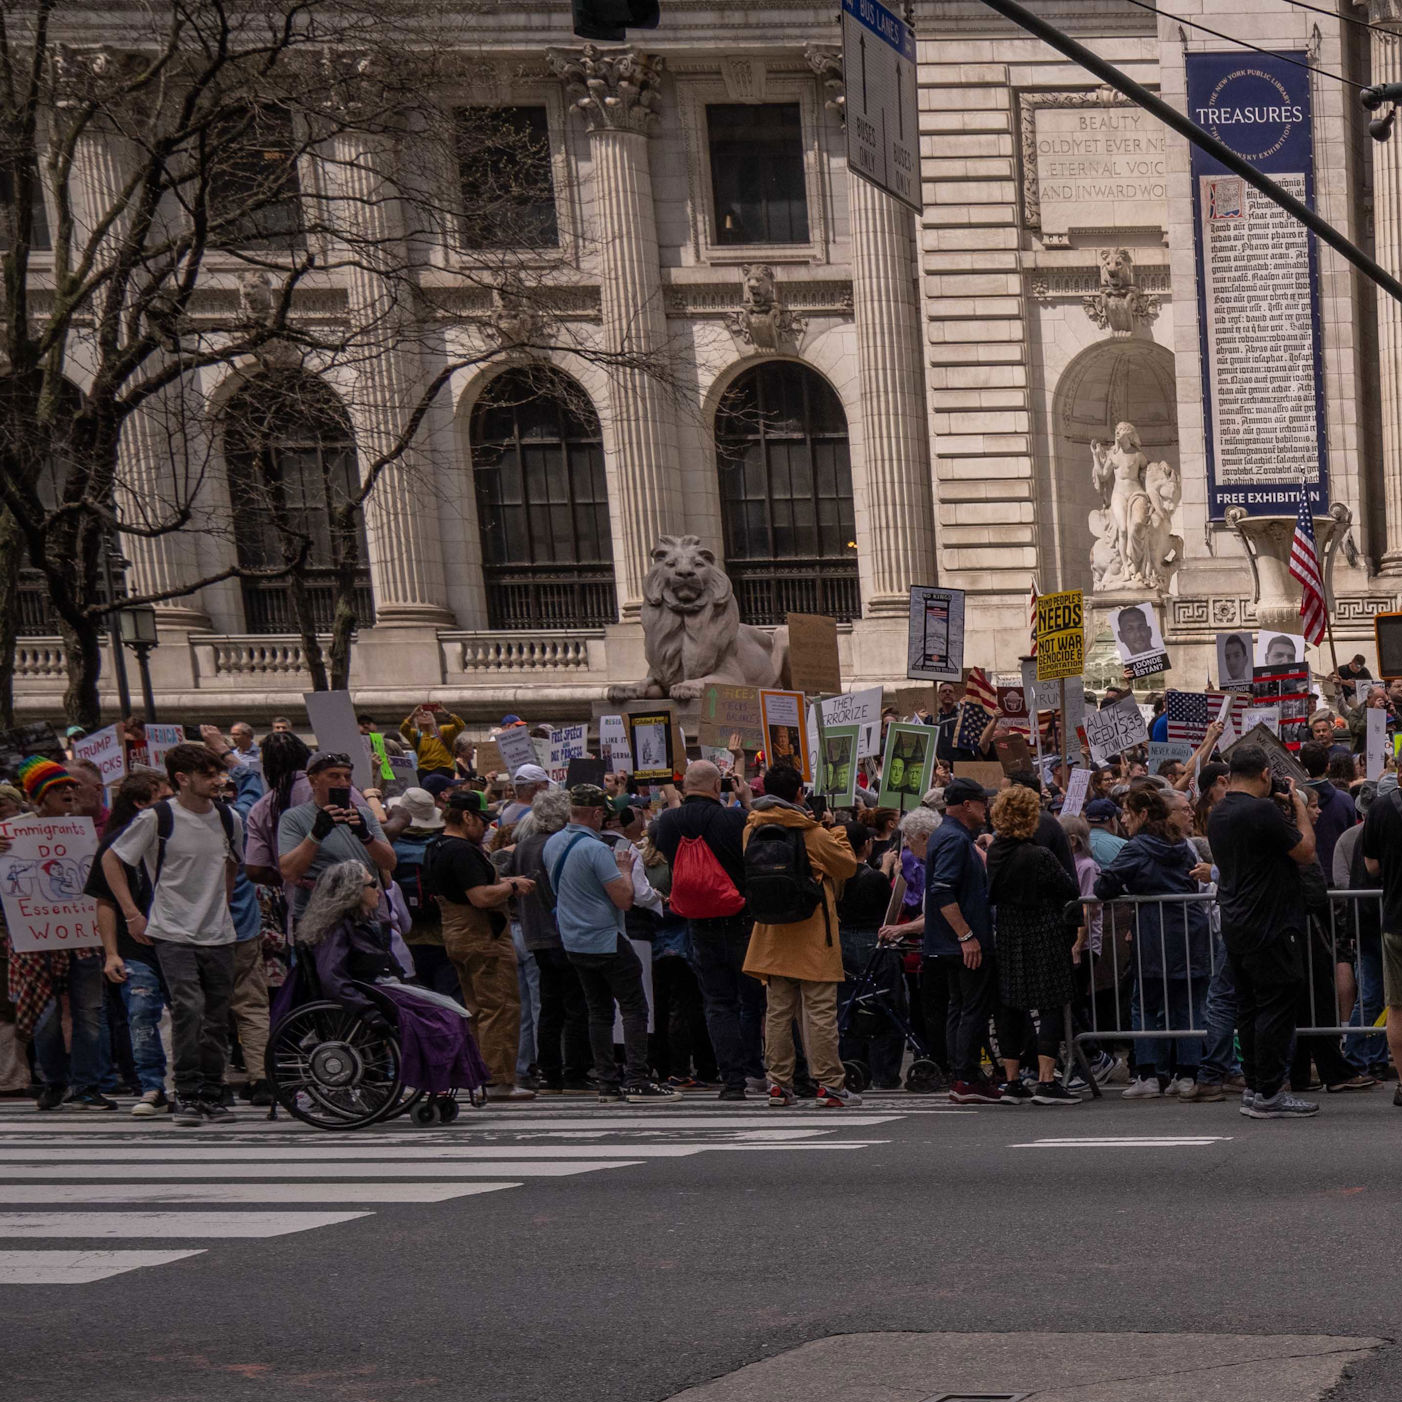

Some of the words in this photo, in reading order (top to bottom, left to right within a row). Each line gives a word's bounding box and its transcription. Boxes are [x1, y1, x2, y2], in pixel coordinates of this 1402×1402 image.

[877, 13, 900, 45] LANES
[1215, 77, 1229, 92] NEW
[1227, 69, 1246, 81] YORK
[1247, 69, 1272, 82] PUBLIC
[1271, 78, 1292, 105] LIBRARY
[1079, 116, 1141, 130] BEAUTY
[1196, 106, 1303, 124] TREASURES
[856, 117, 876, 148] BUSES
[1039, 140, 1071, 153] OLD
[1073, 139, 1101, 152] YET
[1106, 139, 1142, 152] EVER
[1259, 124, 1292, 160] EXHIBITION
[859, 147, 876, 174] ONLY
[893, 142, 912, 173] BUSES
[1050, 162, 1121, 176] ETERNAL
[895, 170, 912, 197] ONLY
[1041, 186, 1072, 200] AND
[1077, 185, 1136, 199] INWARD
[1216, 493, 1245, 503] FREE
[1247, 491, 1319, 503] EXHIBITIN
[1038, 598, 1052, 610] FUND
[1053, 593, 1082, 607] PEOPLE'S
[1038, 604, 1082, 632] NEEDS
[1038, 638, 1056, 654] NOT
[1058, 634, 1082, 651] WAR
[1038, 650, 1075, 666] GENOCIDE
[1038, 660, 1083, 673] DEPORTATION
[833, 695, 855, 710] THEY
[1087, 714, 1103, 733] ALL
[1107, 706, 1123, 723] WE
[605, 736, 619, 744] LIKE
[1089, 730, 1114, 748] NEED
[1114, 719, 1128, 737] IS
[77, 736, 111, 759] TRUMP
[0, 822, 86, 840] Immigrants
[38, 844, 67, 858] DO
